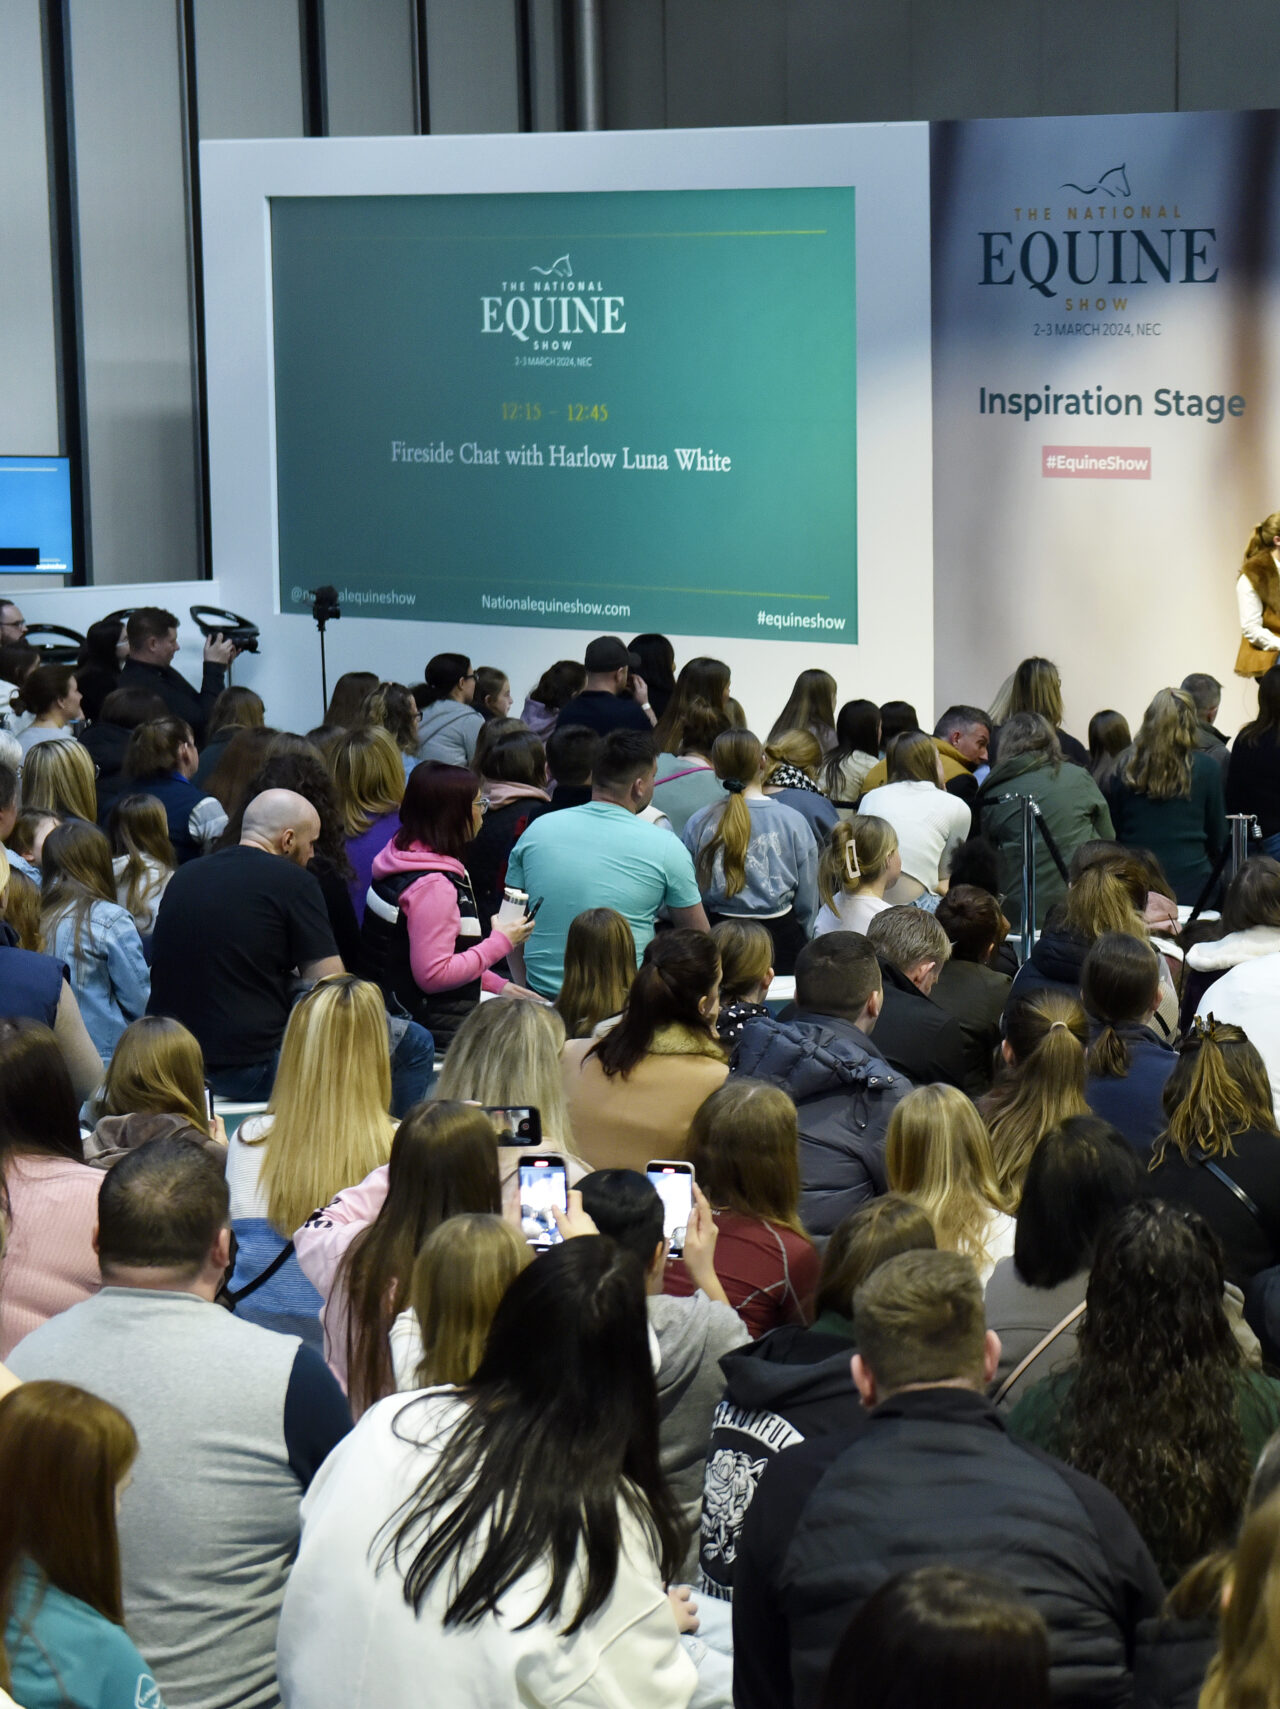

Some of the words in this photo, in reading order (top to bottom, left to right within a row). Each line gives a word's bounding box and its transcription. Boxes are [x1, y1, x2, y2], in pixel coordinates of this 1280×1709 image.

[1014, 207, 1051, 221] THE
[1067, 205, 1181, 220] NATIONAL
[977, 227, 1219, 298] EQUINE
[502, 281, 525, 292] THE
[534, 281, 603, 292] NATIONAL
[1065, 298, 1128, 311] SHOW
[480, 296, 626, 342] EQUINE
[1033, 323, 1052, 336] 2-3
[1055, 323, 1100, 336] MARCH
[1103, 323, 1134, 337] 2024,
[1136, 323, 1162, 336] NEC
[533, 340, 573, 351] SHOW
[528, 356, 556, 367] MARCH
[577, 356, 593, 367] NEC
[502, 402, 542, 420] 12:15
[567, 404, 609, 422] 12:45
[978, 385, 1143, 421] Inspiration
[1154, 389, 1246, 424] Stage
[391, 441, 454, 464] Fireside
[459, 443, 500, 466] Chat
[505, 445, 544, 466] with
[549, 445, 617, 469] Harlow
[622, 447, 670, 471] Luna
[674, 448, 732, 472] White
[1045, 455, 1148, 473] #EquineShow
[481, 594, 631, 617] Nationalequineshow.com
[757, 610, 846, 630] #equineshow
